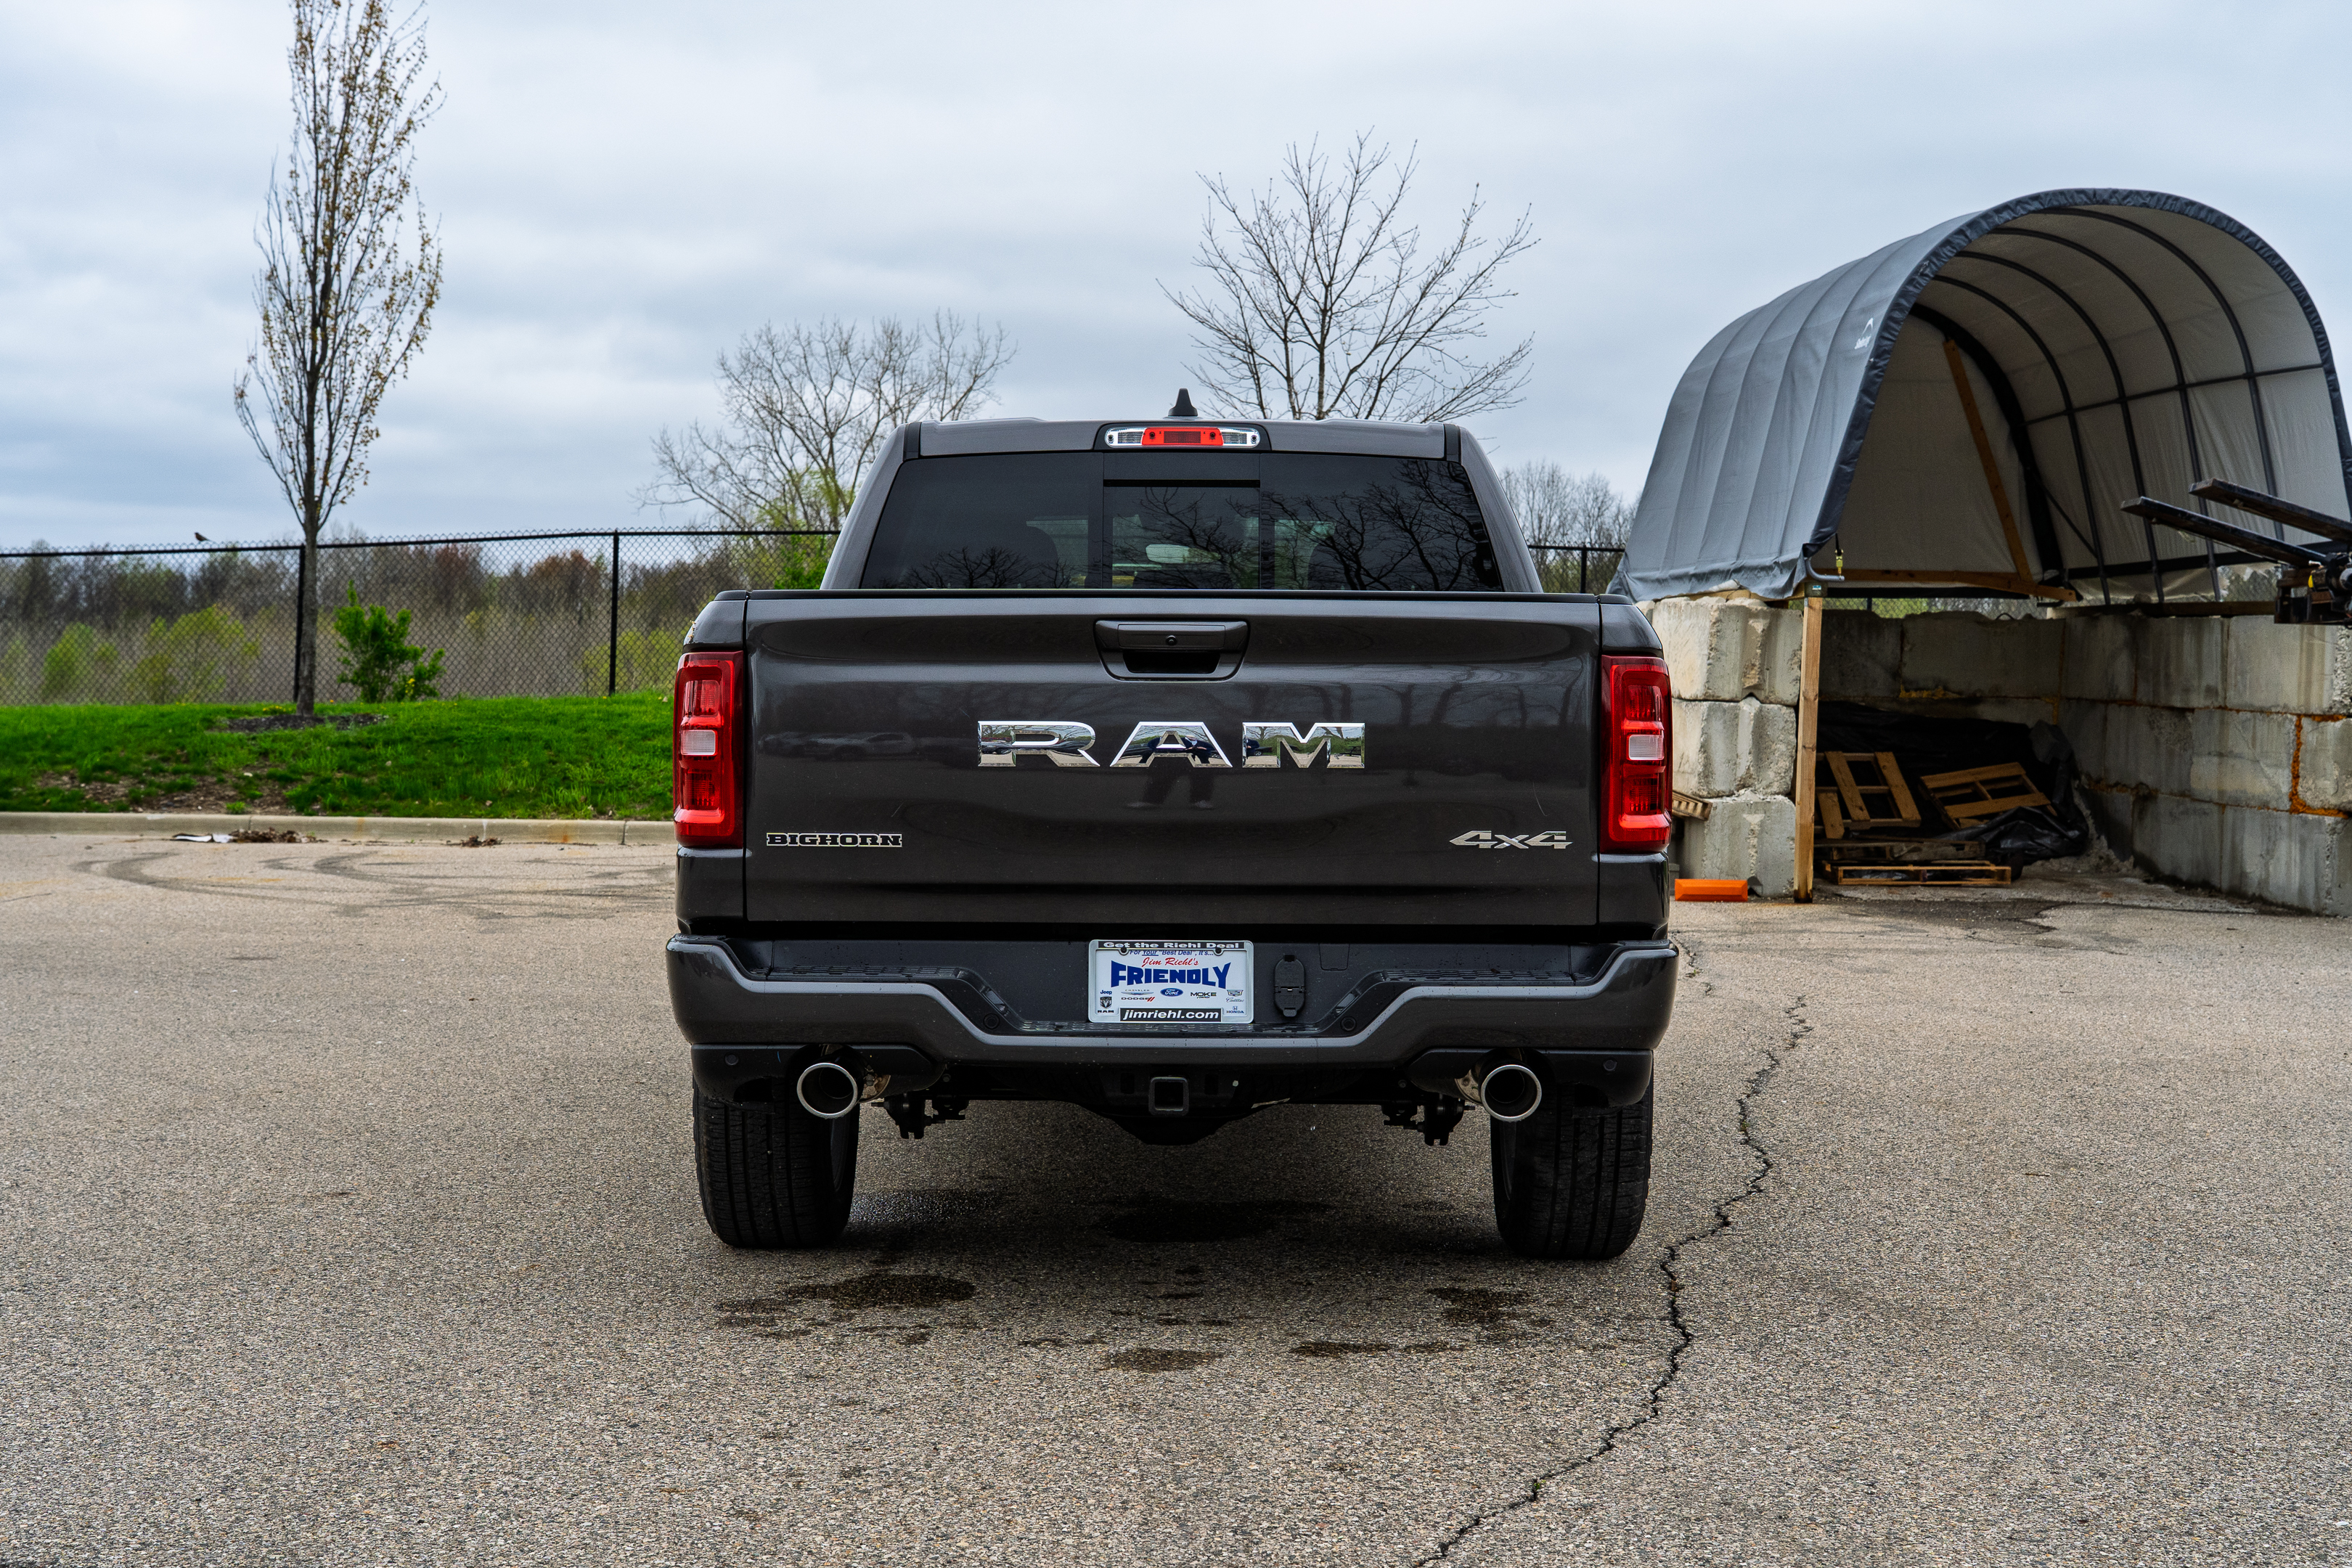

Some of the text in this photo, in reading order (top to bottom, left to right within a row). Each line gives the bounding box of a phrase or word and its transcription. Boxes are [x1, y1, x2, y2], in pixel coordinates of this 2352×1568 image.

[978, 721, 1365, 768] RAM
[767, 833, 902, 847] BIGHORN
[1449, 830, 1573, 849] 4x4
[1141, 957, 1199, 968] Jim Riehl's
[1111, 960, 1231, 989] FRIENDLY
[1123, 1010, 1219, 1021] jimriehl.com
